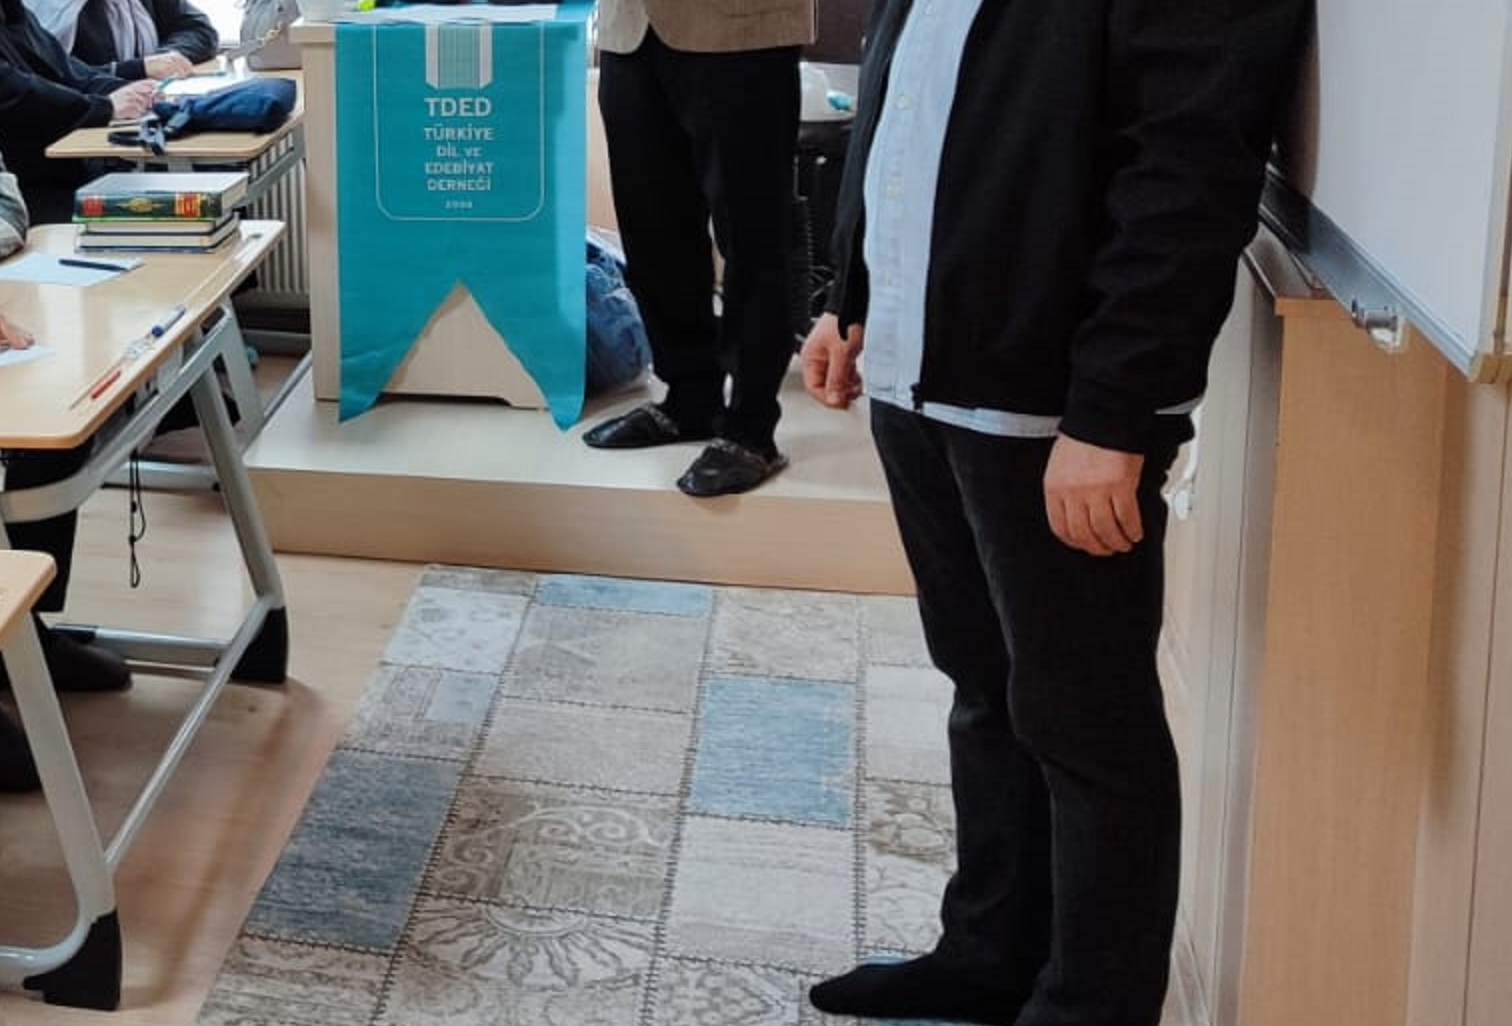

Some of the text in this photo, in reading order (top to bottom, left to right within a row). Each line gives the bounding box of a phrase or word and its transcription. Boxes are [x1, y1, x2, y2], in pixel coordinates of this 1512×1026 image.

[424, 97, 492, 117] TDED
[424, 123, 494, 141] TÜRKİYE
[437, 142, 461, 157] DİL
[425, 158, 494, 174] EDEBİYAT
[427, 175, 491, 190] DERNEĞİ
